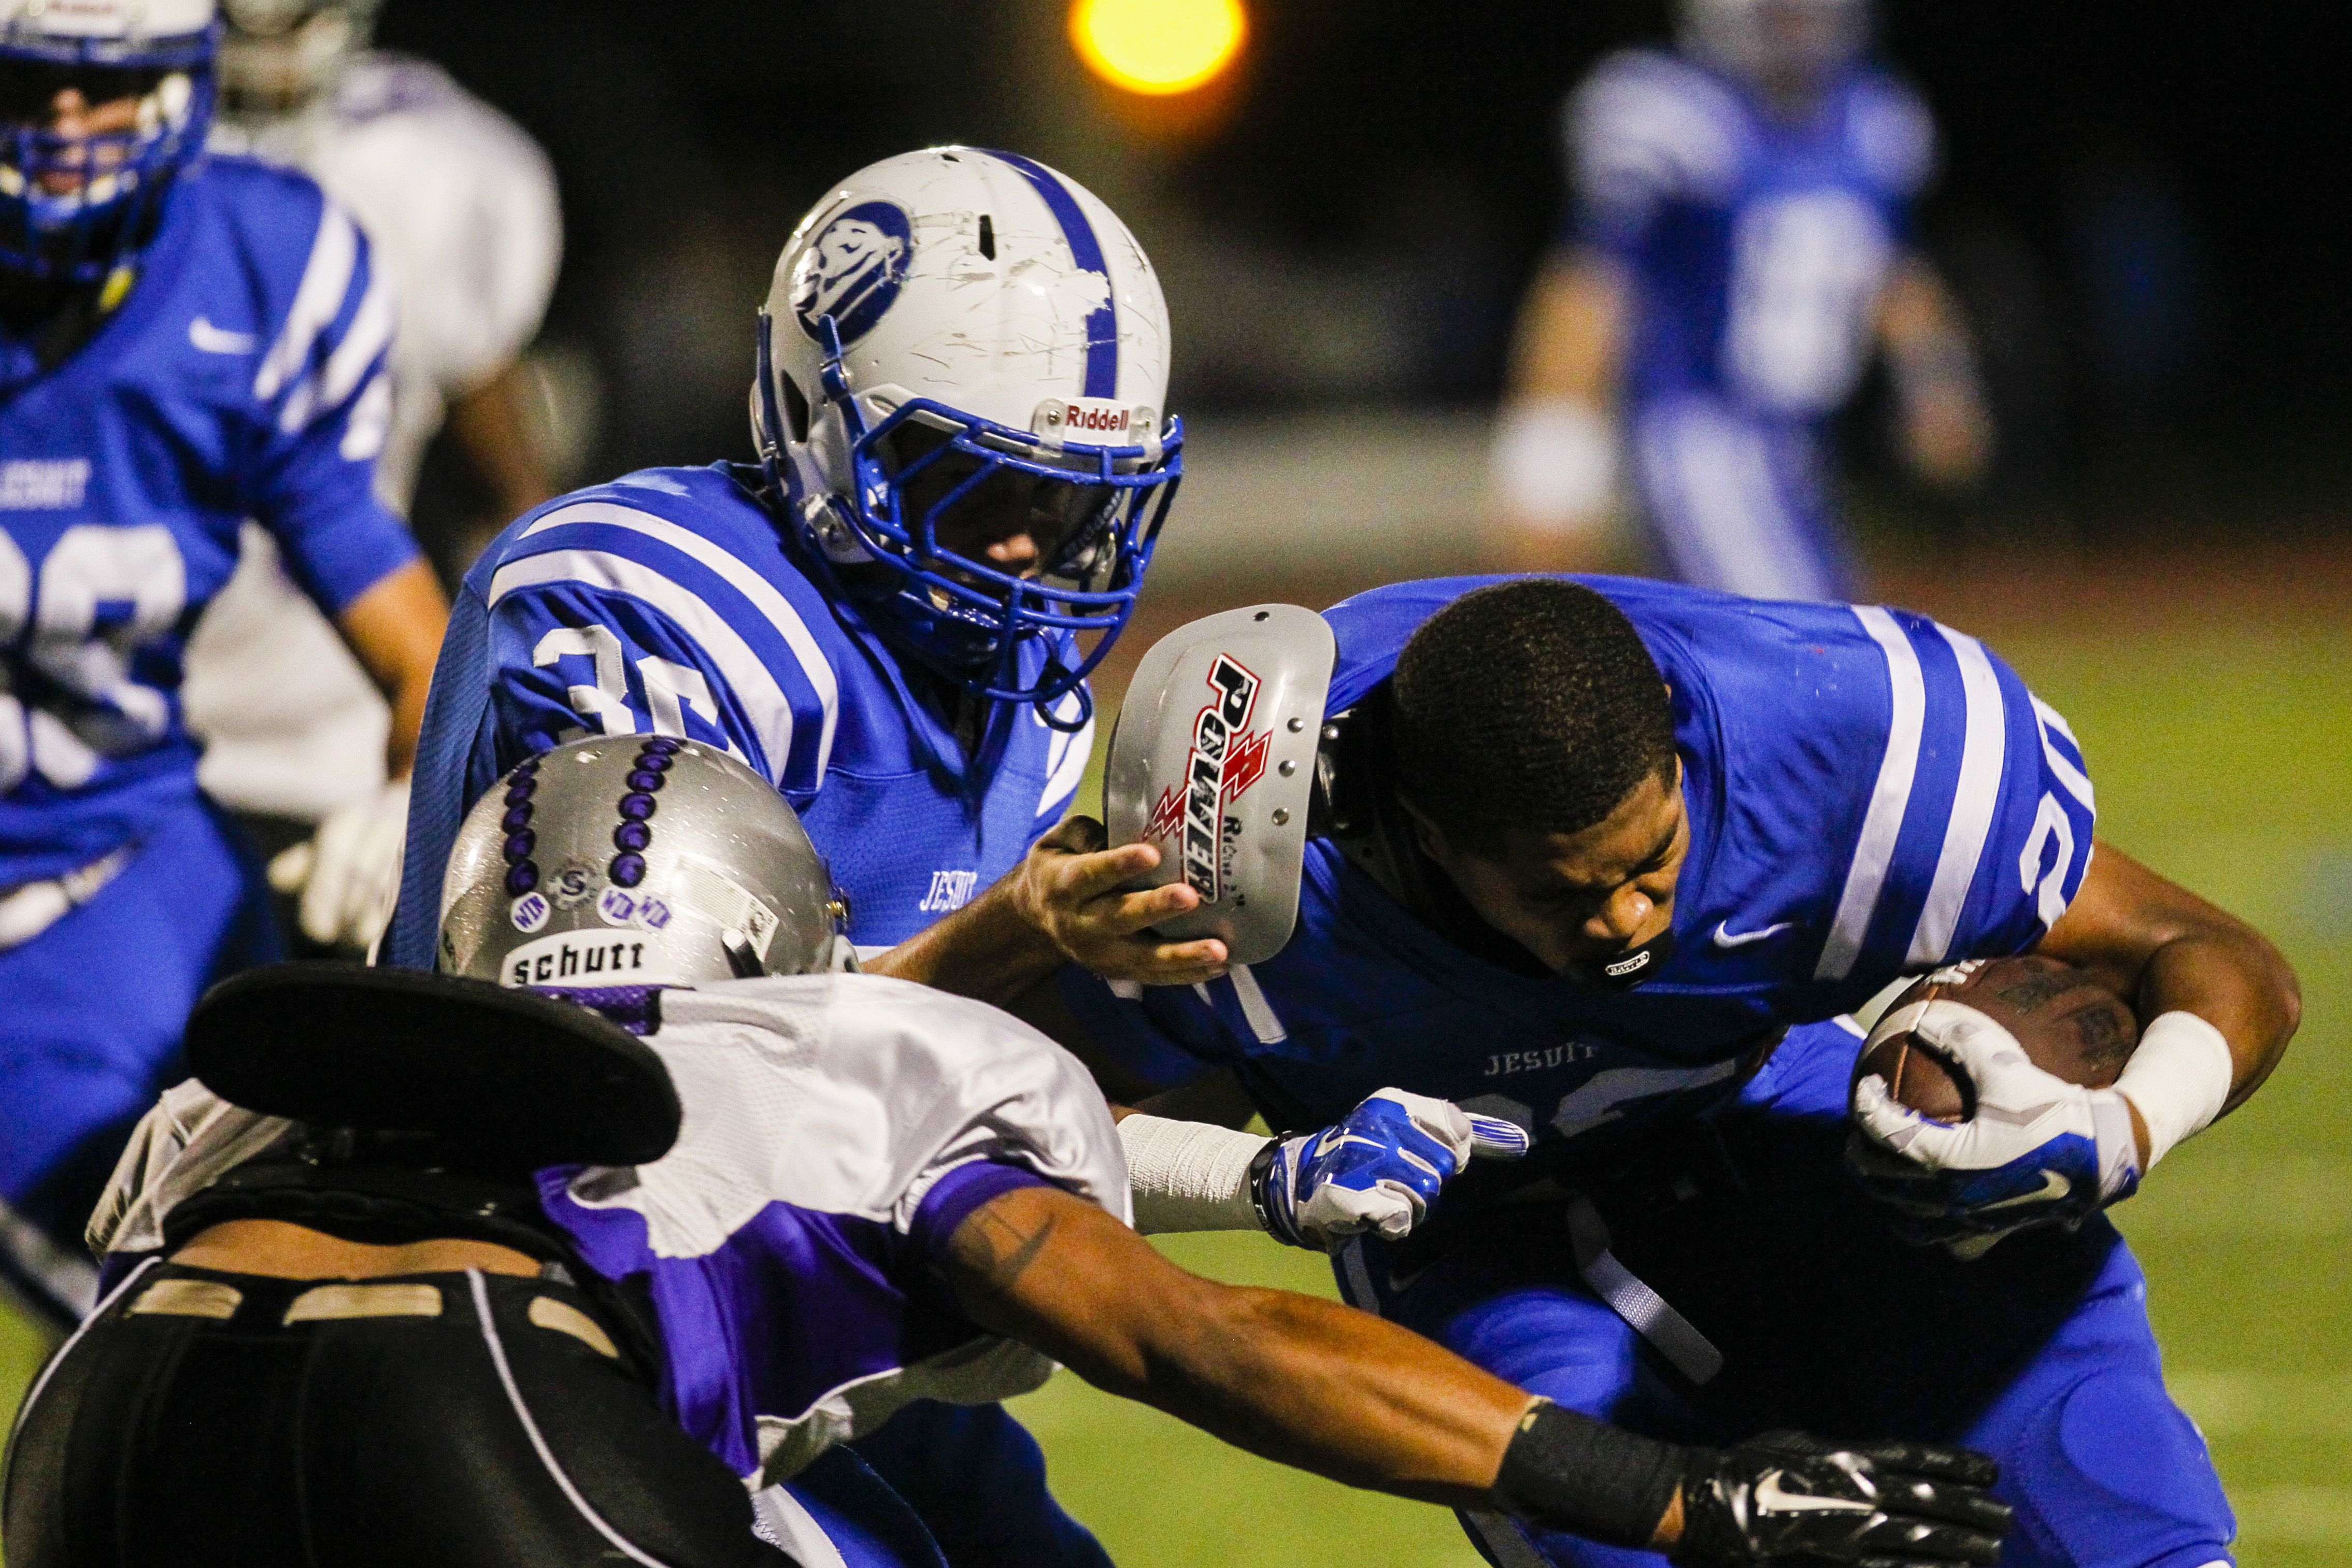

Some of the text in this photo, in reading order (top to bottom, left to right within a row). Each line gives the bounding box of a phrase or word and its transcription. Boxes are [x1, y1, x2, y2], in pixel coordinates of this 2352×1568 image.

[1066, 404, 1129, 431] Riddell
[919, 871, 977, 911] JESUIT
[515, 896, 545, 928] WIN
[515, 941, 644, 985] schutt
[1484, 1041, 1598, 1076] JESUIT
